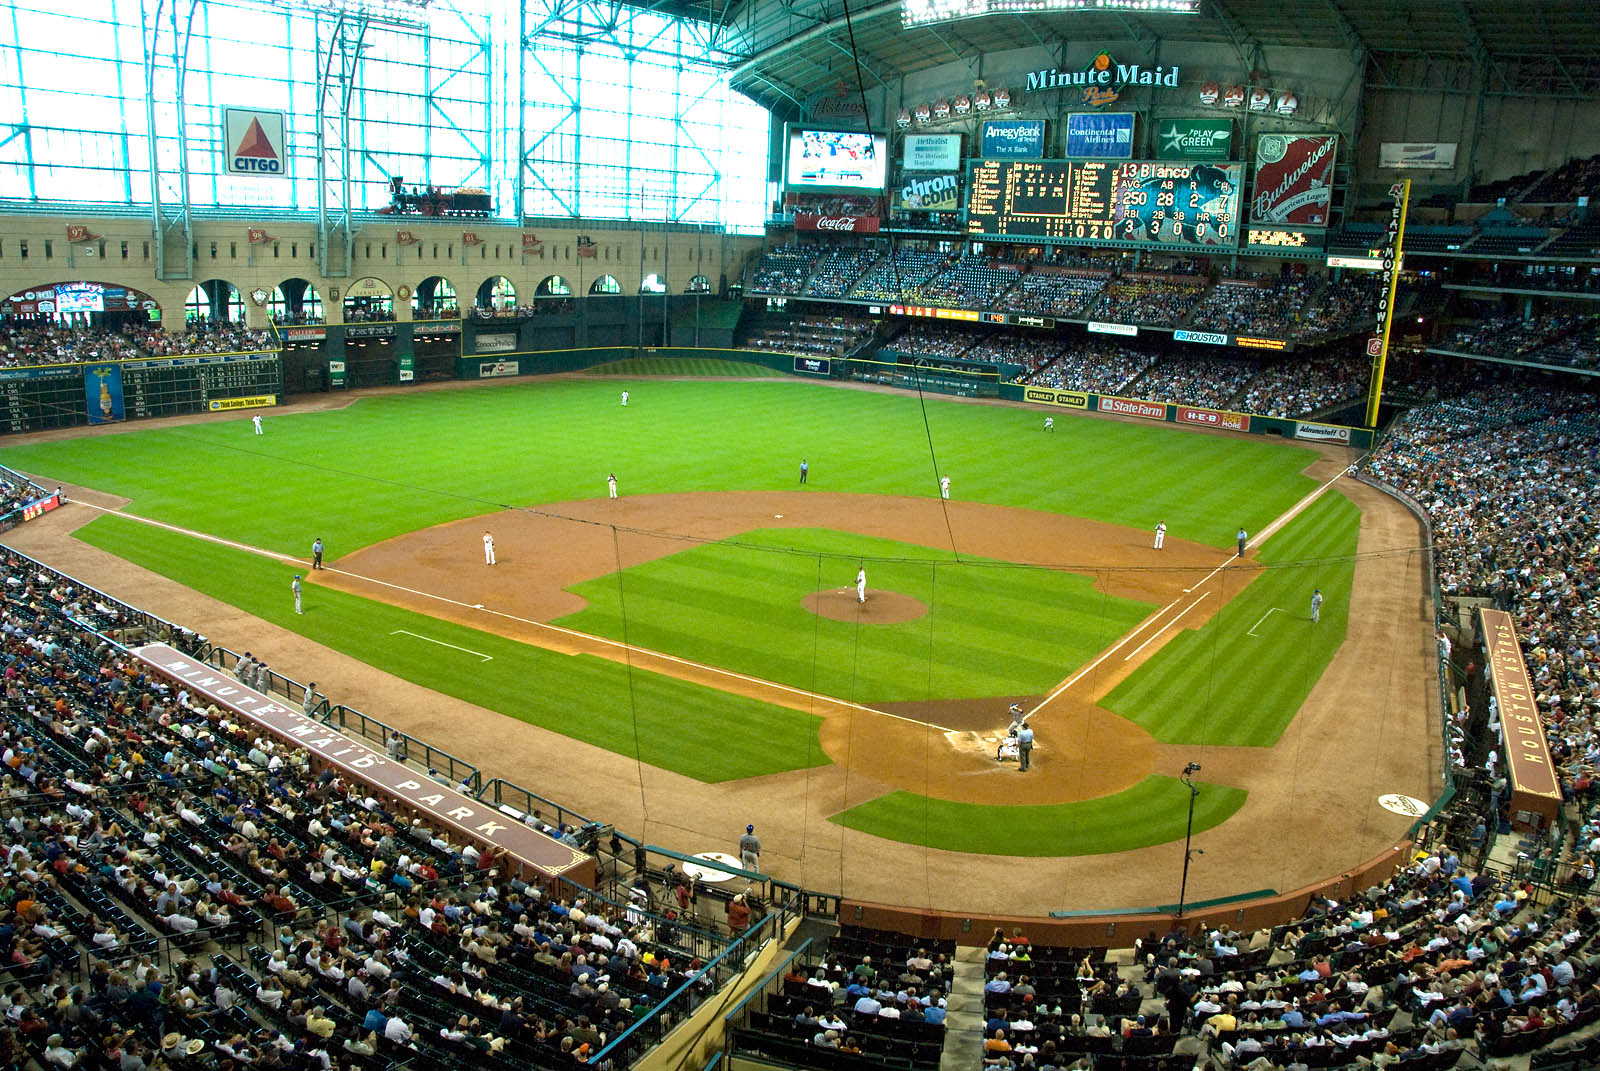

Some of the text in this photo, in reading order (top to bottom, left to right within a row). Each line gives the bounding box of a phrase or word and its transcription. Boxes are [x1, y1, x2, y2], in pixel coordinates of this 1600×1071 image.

[1025, 64, 1180, 92] Minute Maid
[1081, 86, 1120, 106] Park
[985, 126, 1041, 140] AmegyBank
[1069, 128, 1115, 136] Continental
[1181, 137, 1214, 147] GREEN
[234, 158, 279, 172] CITGO
[1121, 163, 1190, 179] 13 Blanco
[1253, 136, 1335, 217] Budweiser
[902, 175, 956, 201] chron
[1120, 180, 1228, 191] AVG. AB R H
[921, 186, 957, 207] com
[1157, 193, 1174, 207] 28
[1189, 194, 1199, 208] 2
[1219, 194, 1229, 209] 7
[1274, 191, 1327, 218] American Lager
[1123, 209, 1231, 222] RBI 2B 3B HR SB
[71, 228, 83, 237] 97
[252, 232, 263, 240] 98
[1076, 225, 1113, 239] 0 2 0
[1125, 219, 1228, 238] 3 3 0 0 0
[1375, 207, 1400, 335] EAT MOR FOWL
[1029, 391, 1053, 400] STANLEY
[1059, 396, 1084, 405] STANLEY
[1113, 399, 1163, 417] State Farm
[1221, 420, 1241, 430] MORE
[1299, 424, 1337, 437] Administaff
[1495, 624, 1544, 764] HOUSTON ASTROS
[165, 660, 374, 768] MINUTE MAID
[395, 779, 508, 837] PARK
